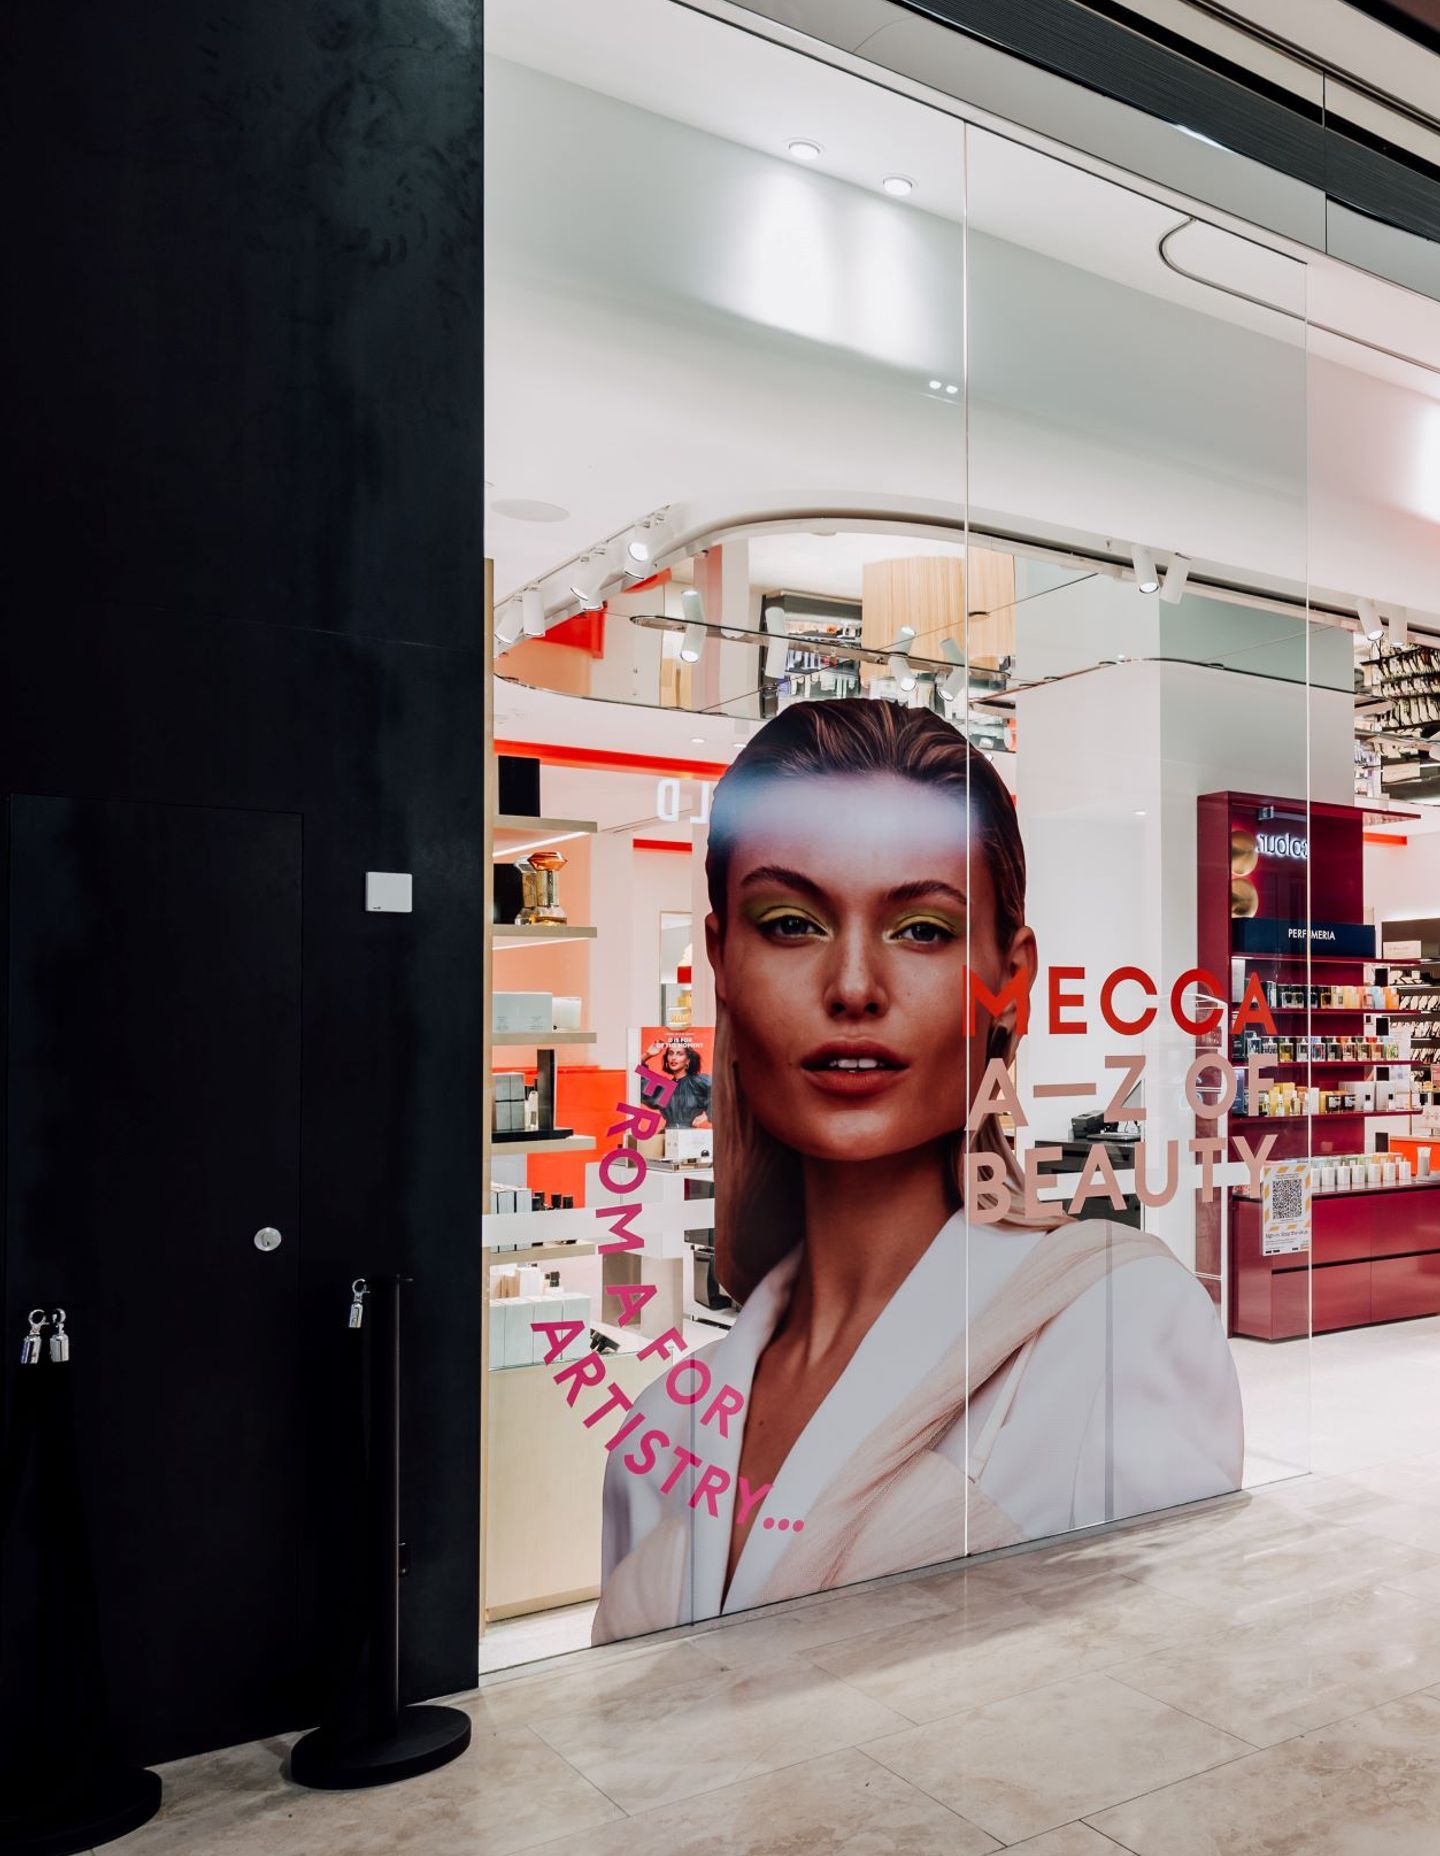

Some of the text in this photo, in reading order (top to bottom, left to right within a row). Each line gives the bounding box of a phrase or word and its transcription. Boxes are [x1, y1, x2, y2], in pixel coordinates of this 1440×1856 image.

[1288, 928, 1336, 940] PERFMERIA
[962, 965, 1278, 1037] MECCA
[1185, 1052, 1279, 1120] OF
[964, 1134, 1279, 1224] BEAUTY
[595, 1063, 745, 1438] FROM A FOR
